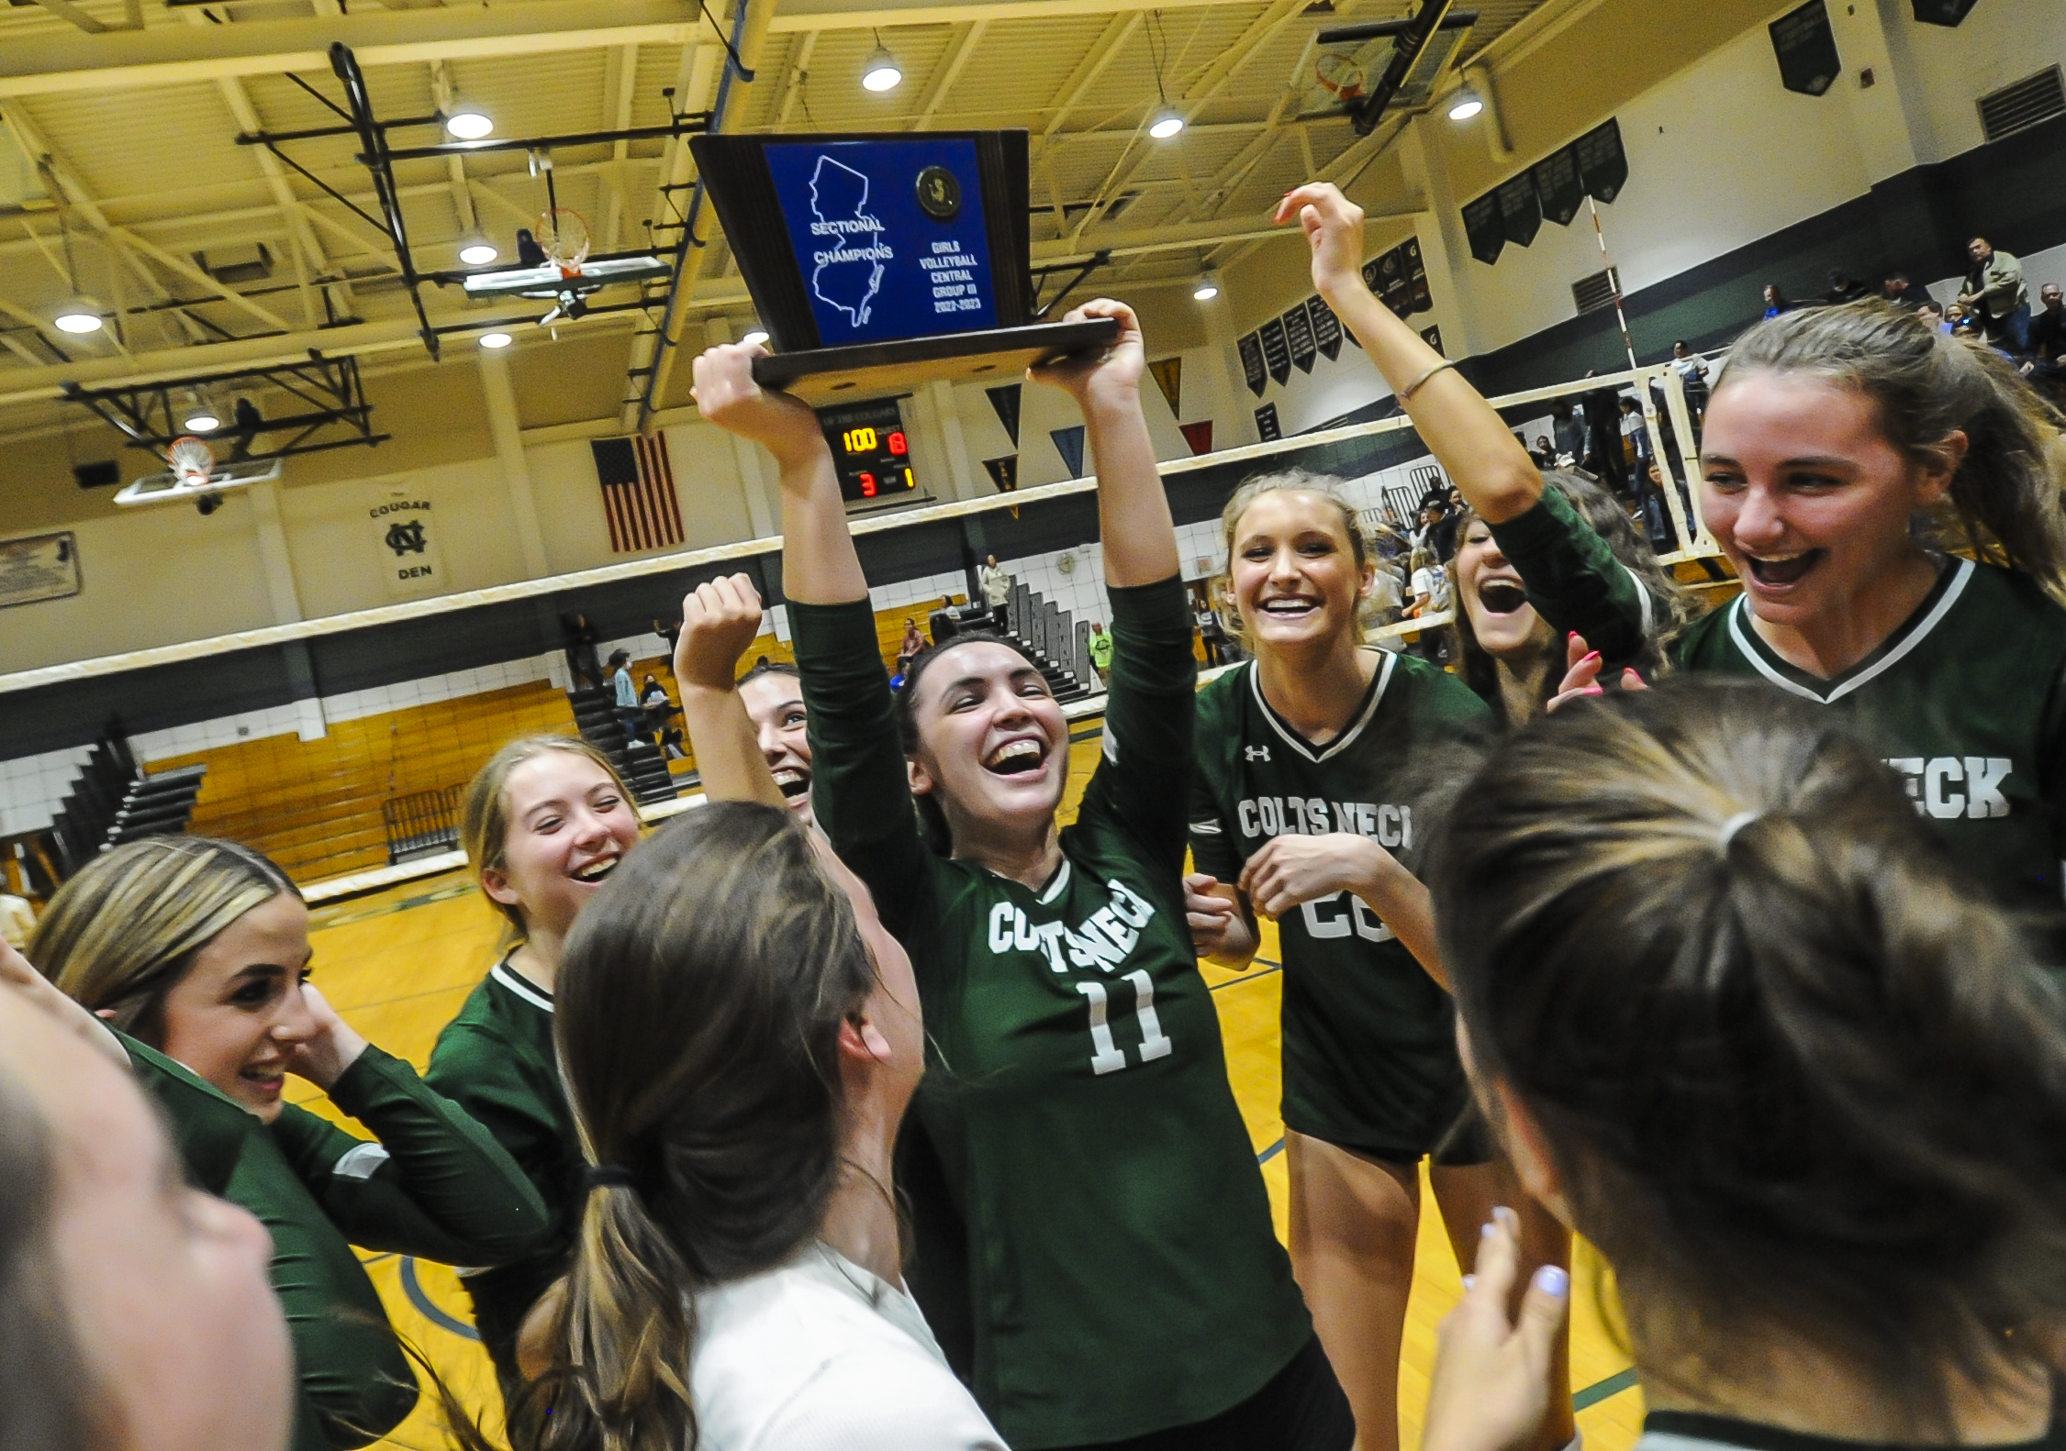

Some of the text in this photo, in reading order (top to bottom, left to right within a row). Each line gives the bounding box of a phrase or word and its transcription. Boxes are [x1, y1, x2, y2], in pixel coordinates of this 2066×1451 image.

[811, 219, 884, 235] SECTIONAL
[931, 240, 960, 253] GIRLS
[814, 246, 893, 264] CHAMPIONS
[919, 254, 978, 269] VOLLEYBALL
[931, 270, 973, 283] CENTRAL
[932, 283, 977, 298] GROUP III
[934, 297, 981, 313] 2022-2023
[860, 473, 876, 496] 3
[905, 468, 914, 487] 1
[370, 501, 430, 518] COUGAR
[398, 565, 432, 580] DEN
[1238, 797, 1329, 838] COLTS
[1075, 969, 1172, 1075] 11
